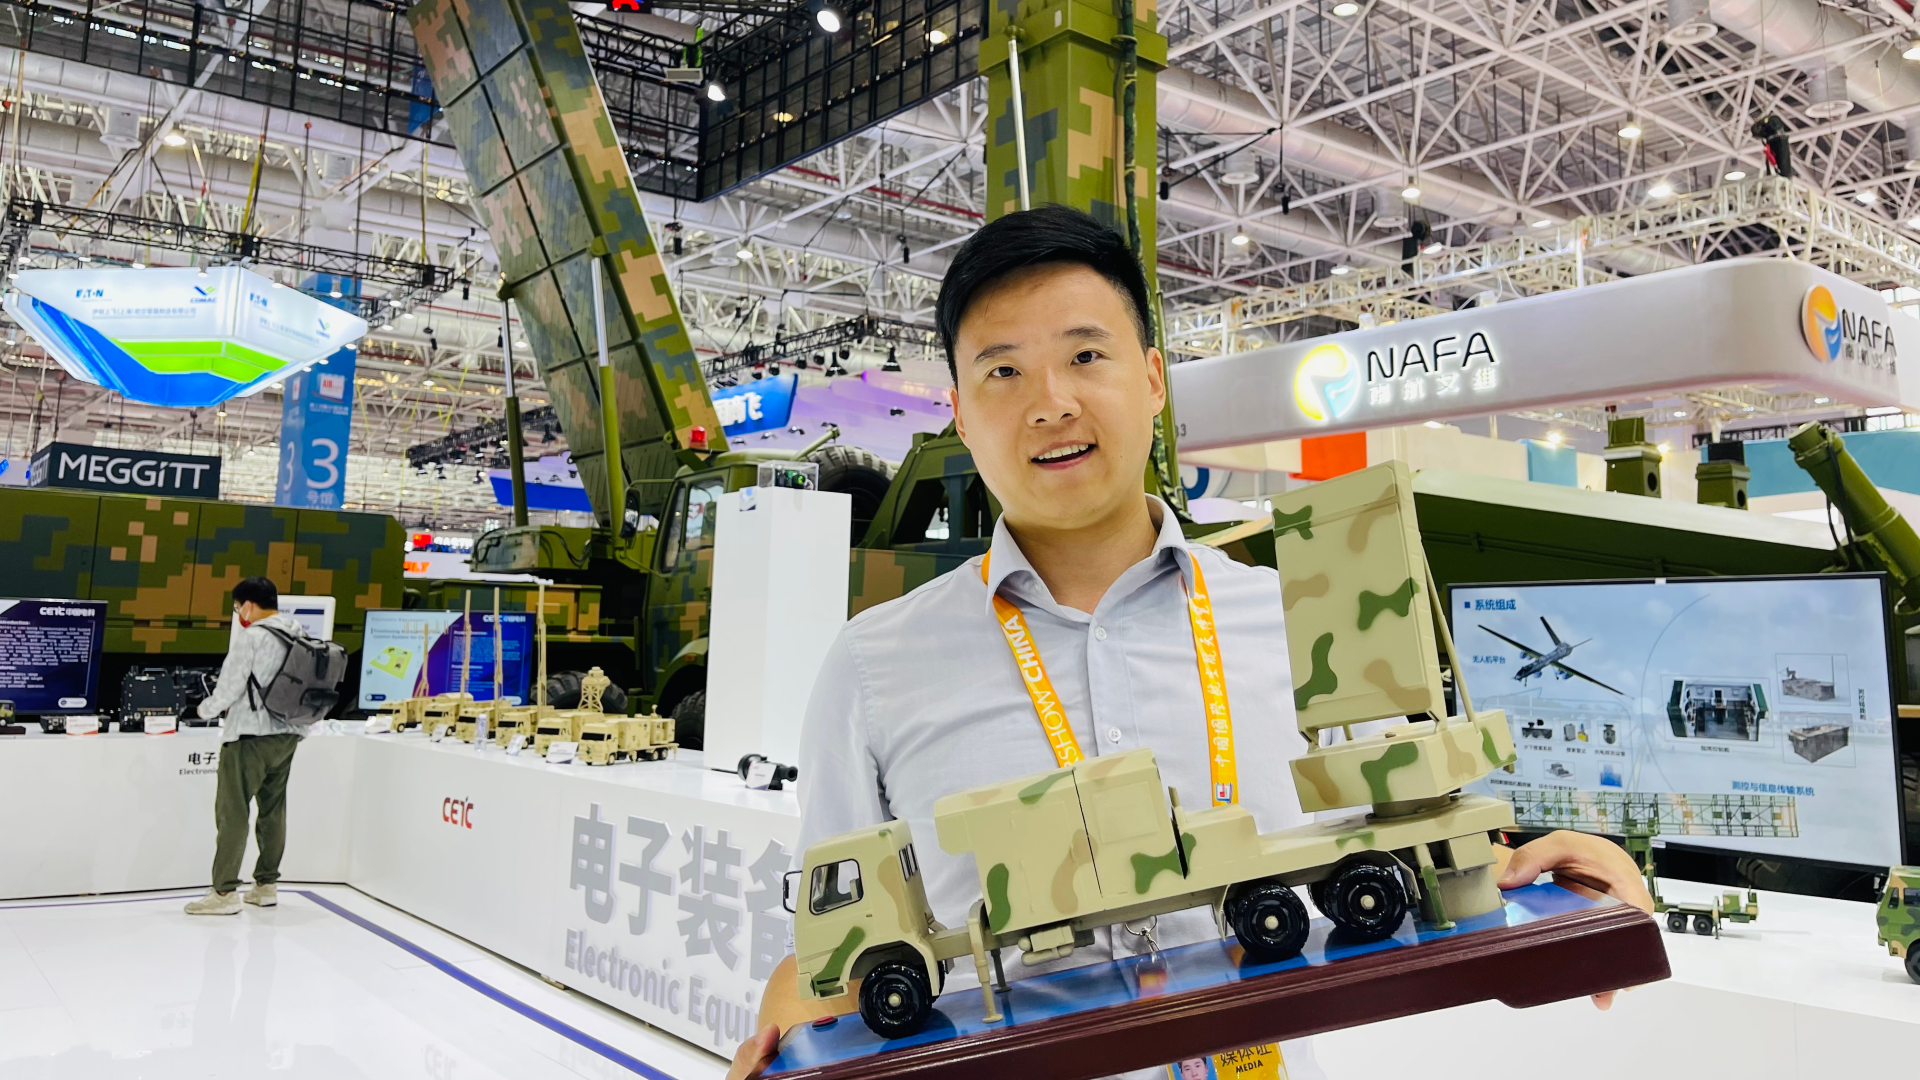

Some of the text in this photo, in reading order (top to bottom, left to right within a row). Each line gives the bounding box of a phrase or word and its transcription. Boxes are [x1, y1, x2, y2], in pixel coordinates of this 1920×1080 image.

[1842, 309, 1898, 357] NAFA
[1367, 332, 1496, 383] NAFA
[58, 451, 211, 491] MEGGITT
[307, 437, 339, 490] 3
[1475, 598, 1517, 611] 系统组成
[1003, 614, 1043, 684] CHINA
[188, 752, 216, 765] 电子
[564, 927, 760, 1048] Electronic Equi
[1236, 1059, 1264, 1074] MEDIA
